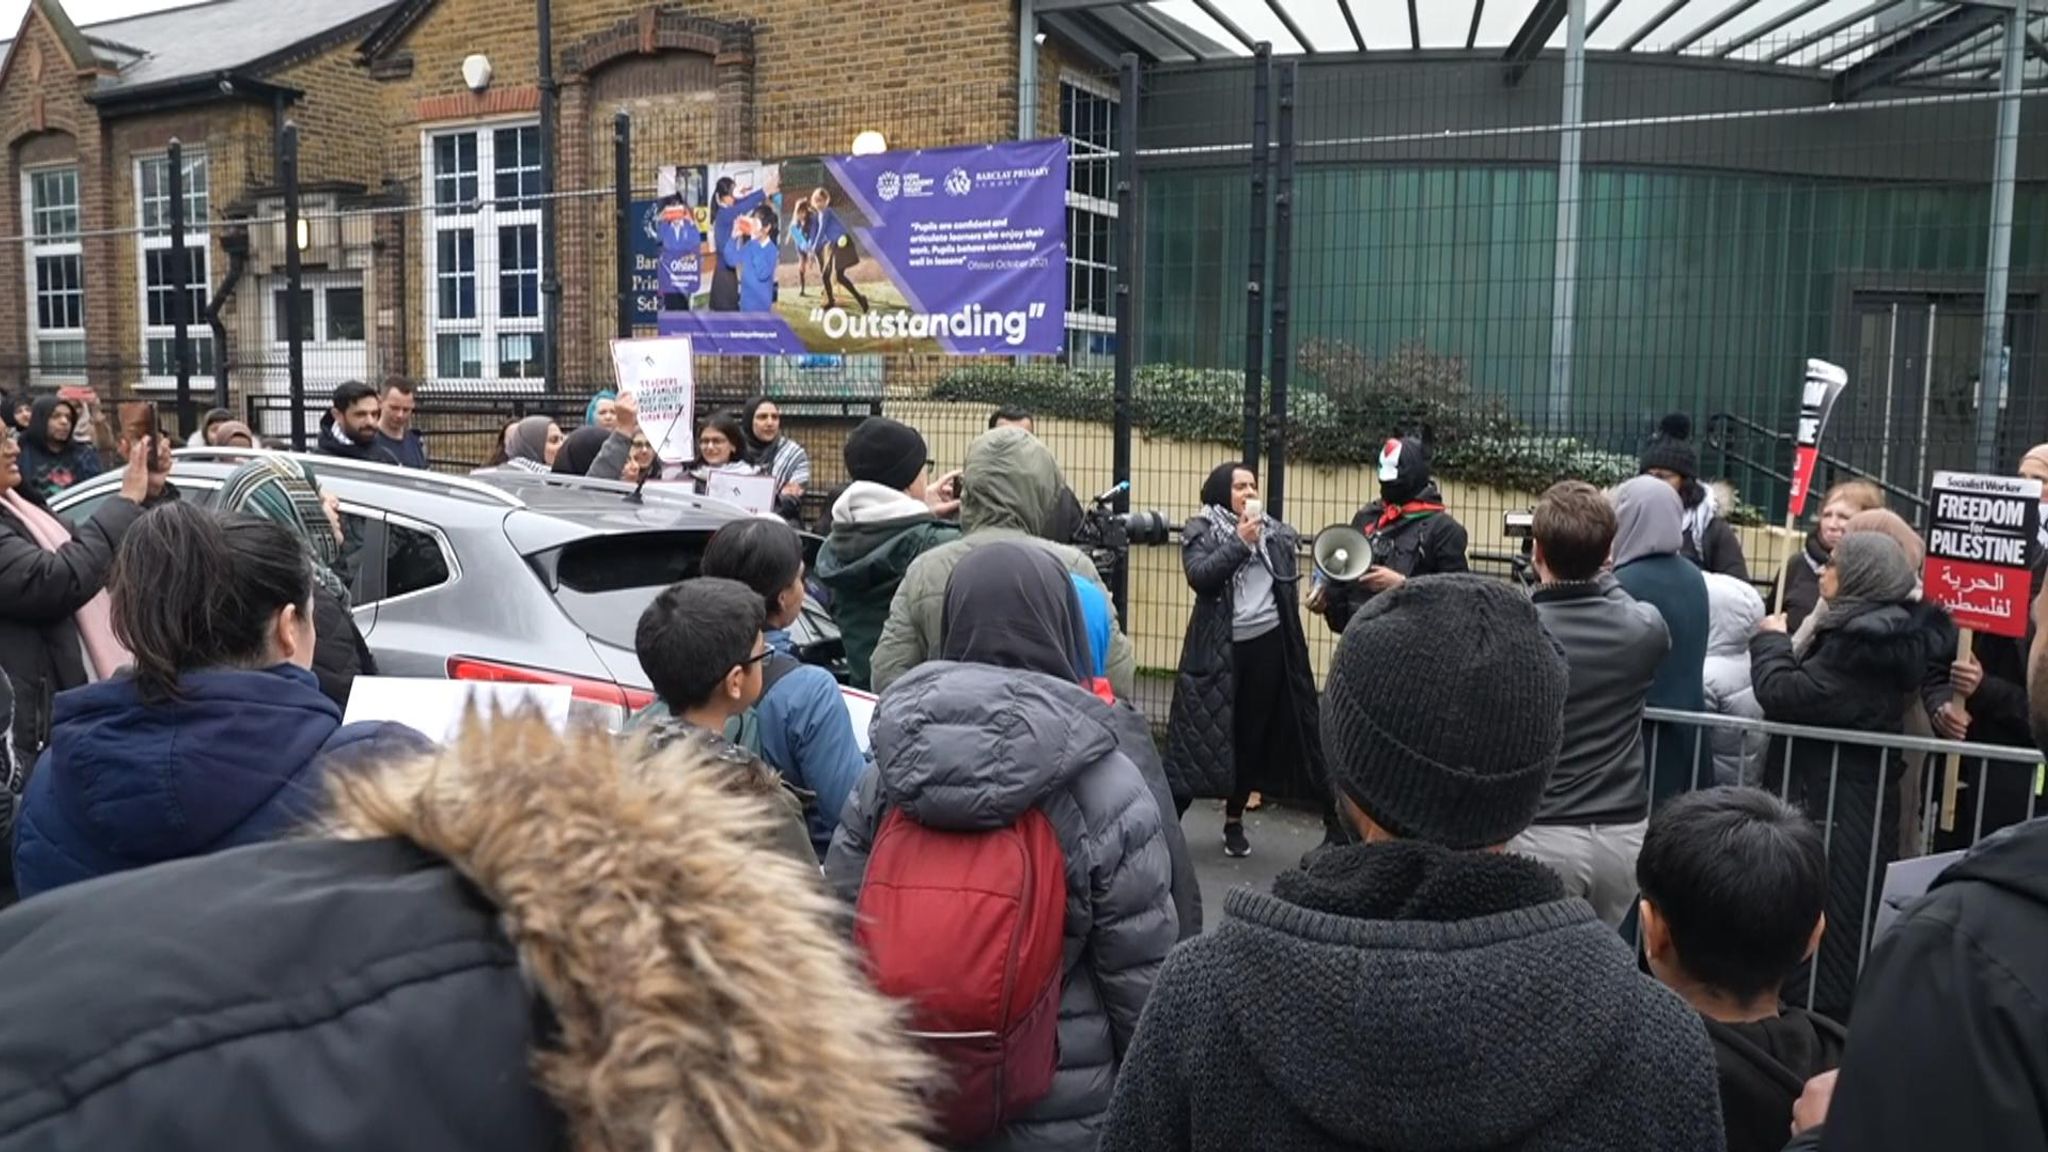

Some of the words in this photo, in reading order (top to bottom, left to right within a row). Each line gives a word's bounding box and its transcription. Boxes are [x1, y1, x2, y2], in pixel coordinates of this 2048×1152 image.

[976, 170, 1011, 181] BARCLAY
[1013, 167, 1049, 178] PRIMARY
[954, 220, 991, 229] confident
[992, 218, 1008, 227] and
[910, 233, 948, 243] articulate
[949, 232, 981, 242] learners
[983, 231, 999, 240] who
[1001, 229, 1024, 241] enjoy
[1025, 227, 1045, 238] their
[932, 244, 955, 256] Pupils
[956, 243, 986, 252] behave
[987, 241, 1036, 252] consistently
[670, 259, 698, 272] Ofsted
[909, 257, 925, 266] well
[967, 260, 994, 270] Ofsted
[996, 259, 1029, 269] October
[652, 386, 683, 395] FAMILIES
[640, 404, 673, 413] DUCATION
[1937, 493, 2026, 527] FREEDOM
[1968, 520, 1986, 535] for
[1930, 529, 2027, 565] PALESTINE
[1941, 565, 2004, 593] الحرية
[1932, 592, 2011, 618] لفلسطين
